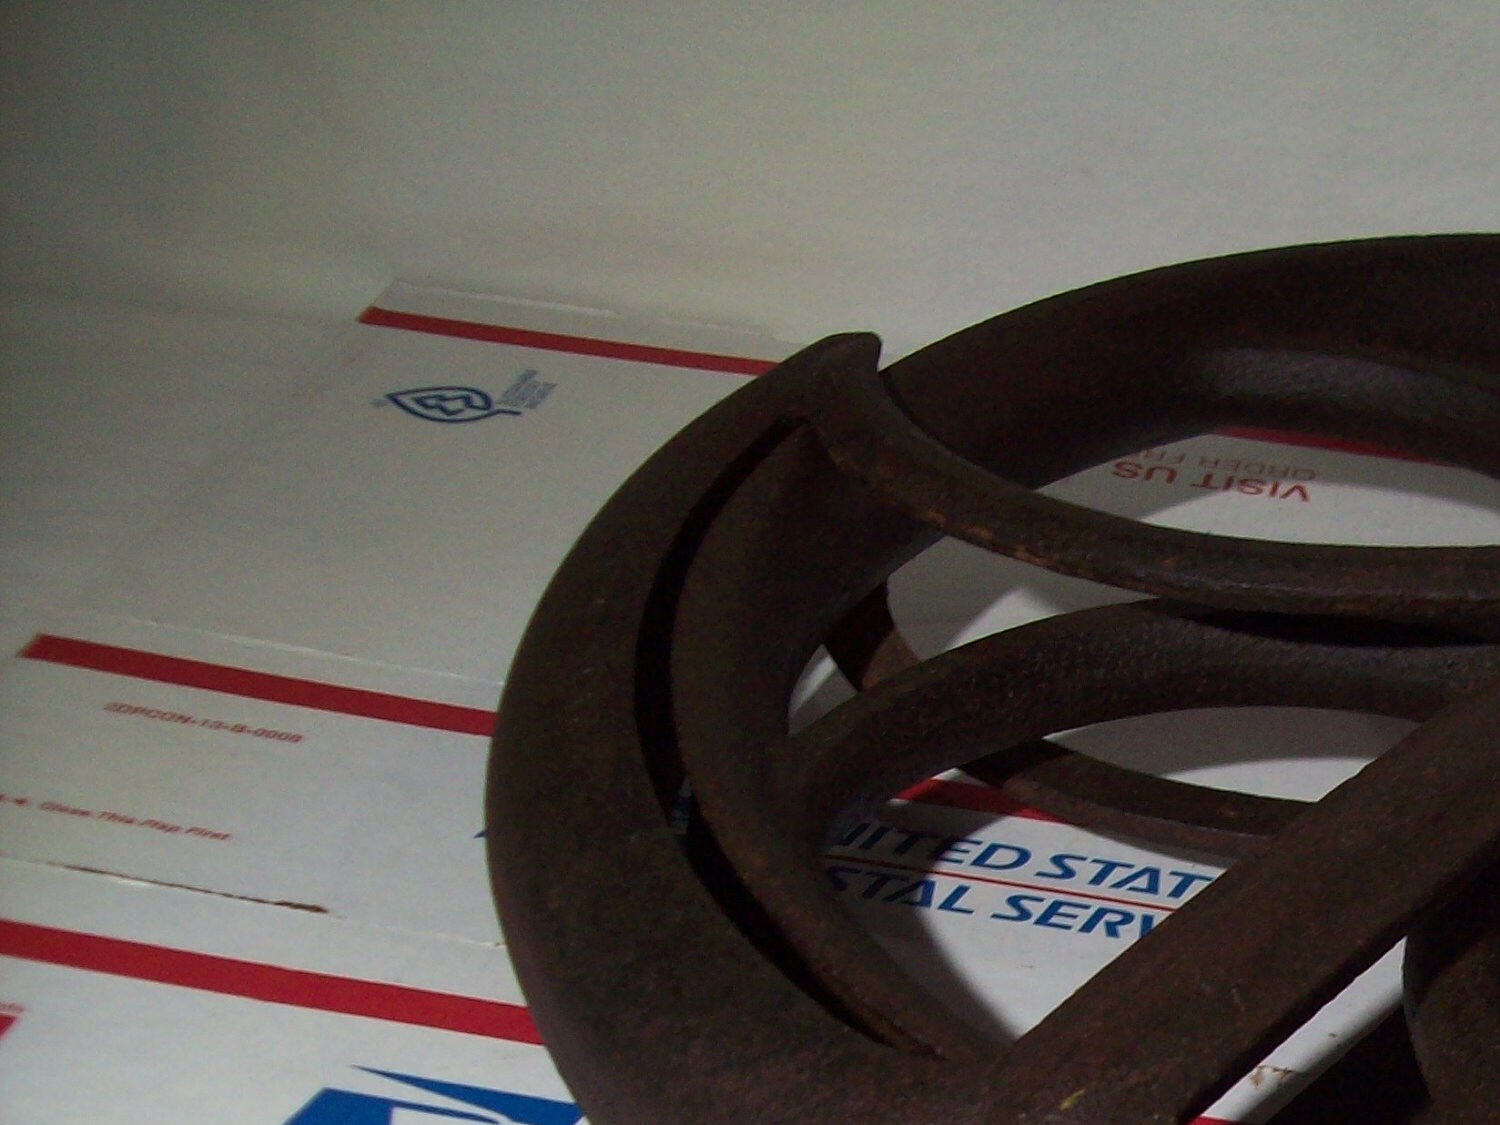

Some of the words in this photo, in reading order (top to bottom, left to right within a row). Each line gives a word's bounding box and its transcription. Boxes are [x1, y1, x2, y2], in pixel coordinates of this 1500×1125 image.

[1113, 460, 1178, 485] US
[1190, 472, 1309, 502] VISIT
[1035, 854, 1214, 899] STAT
